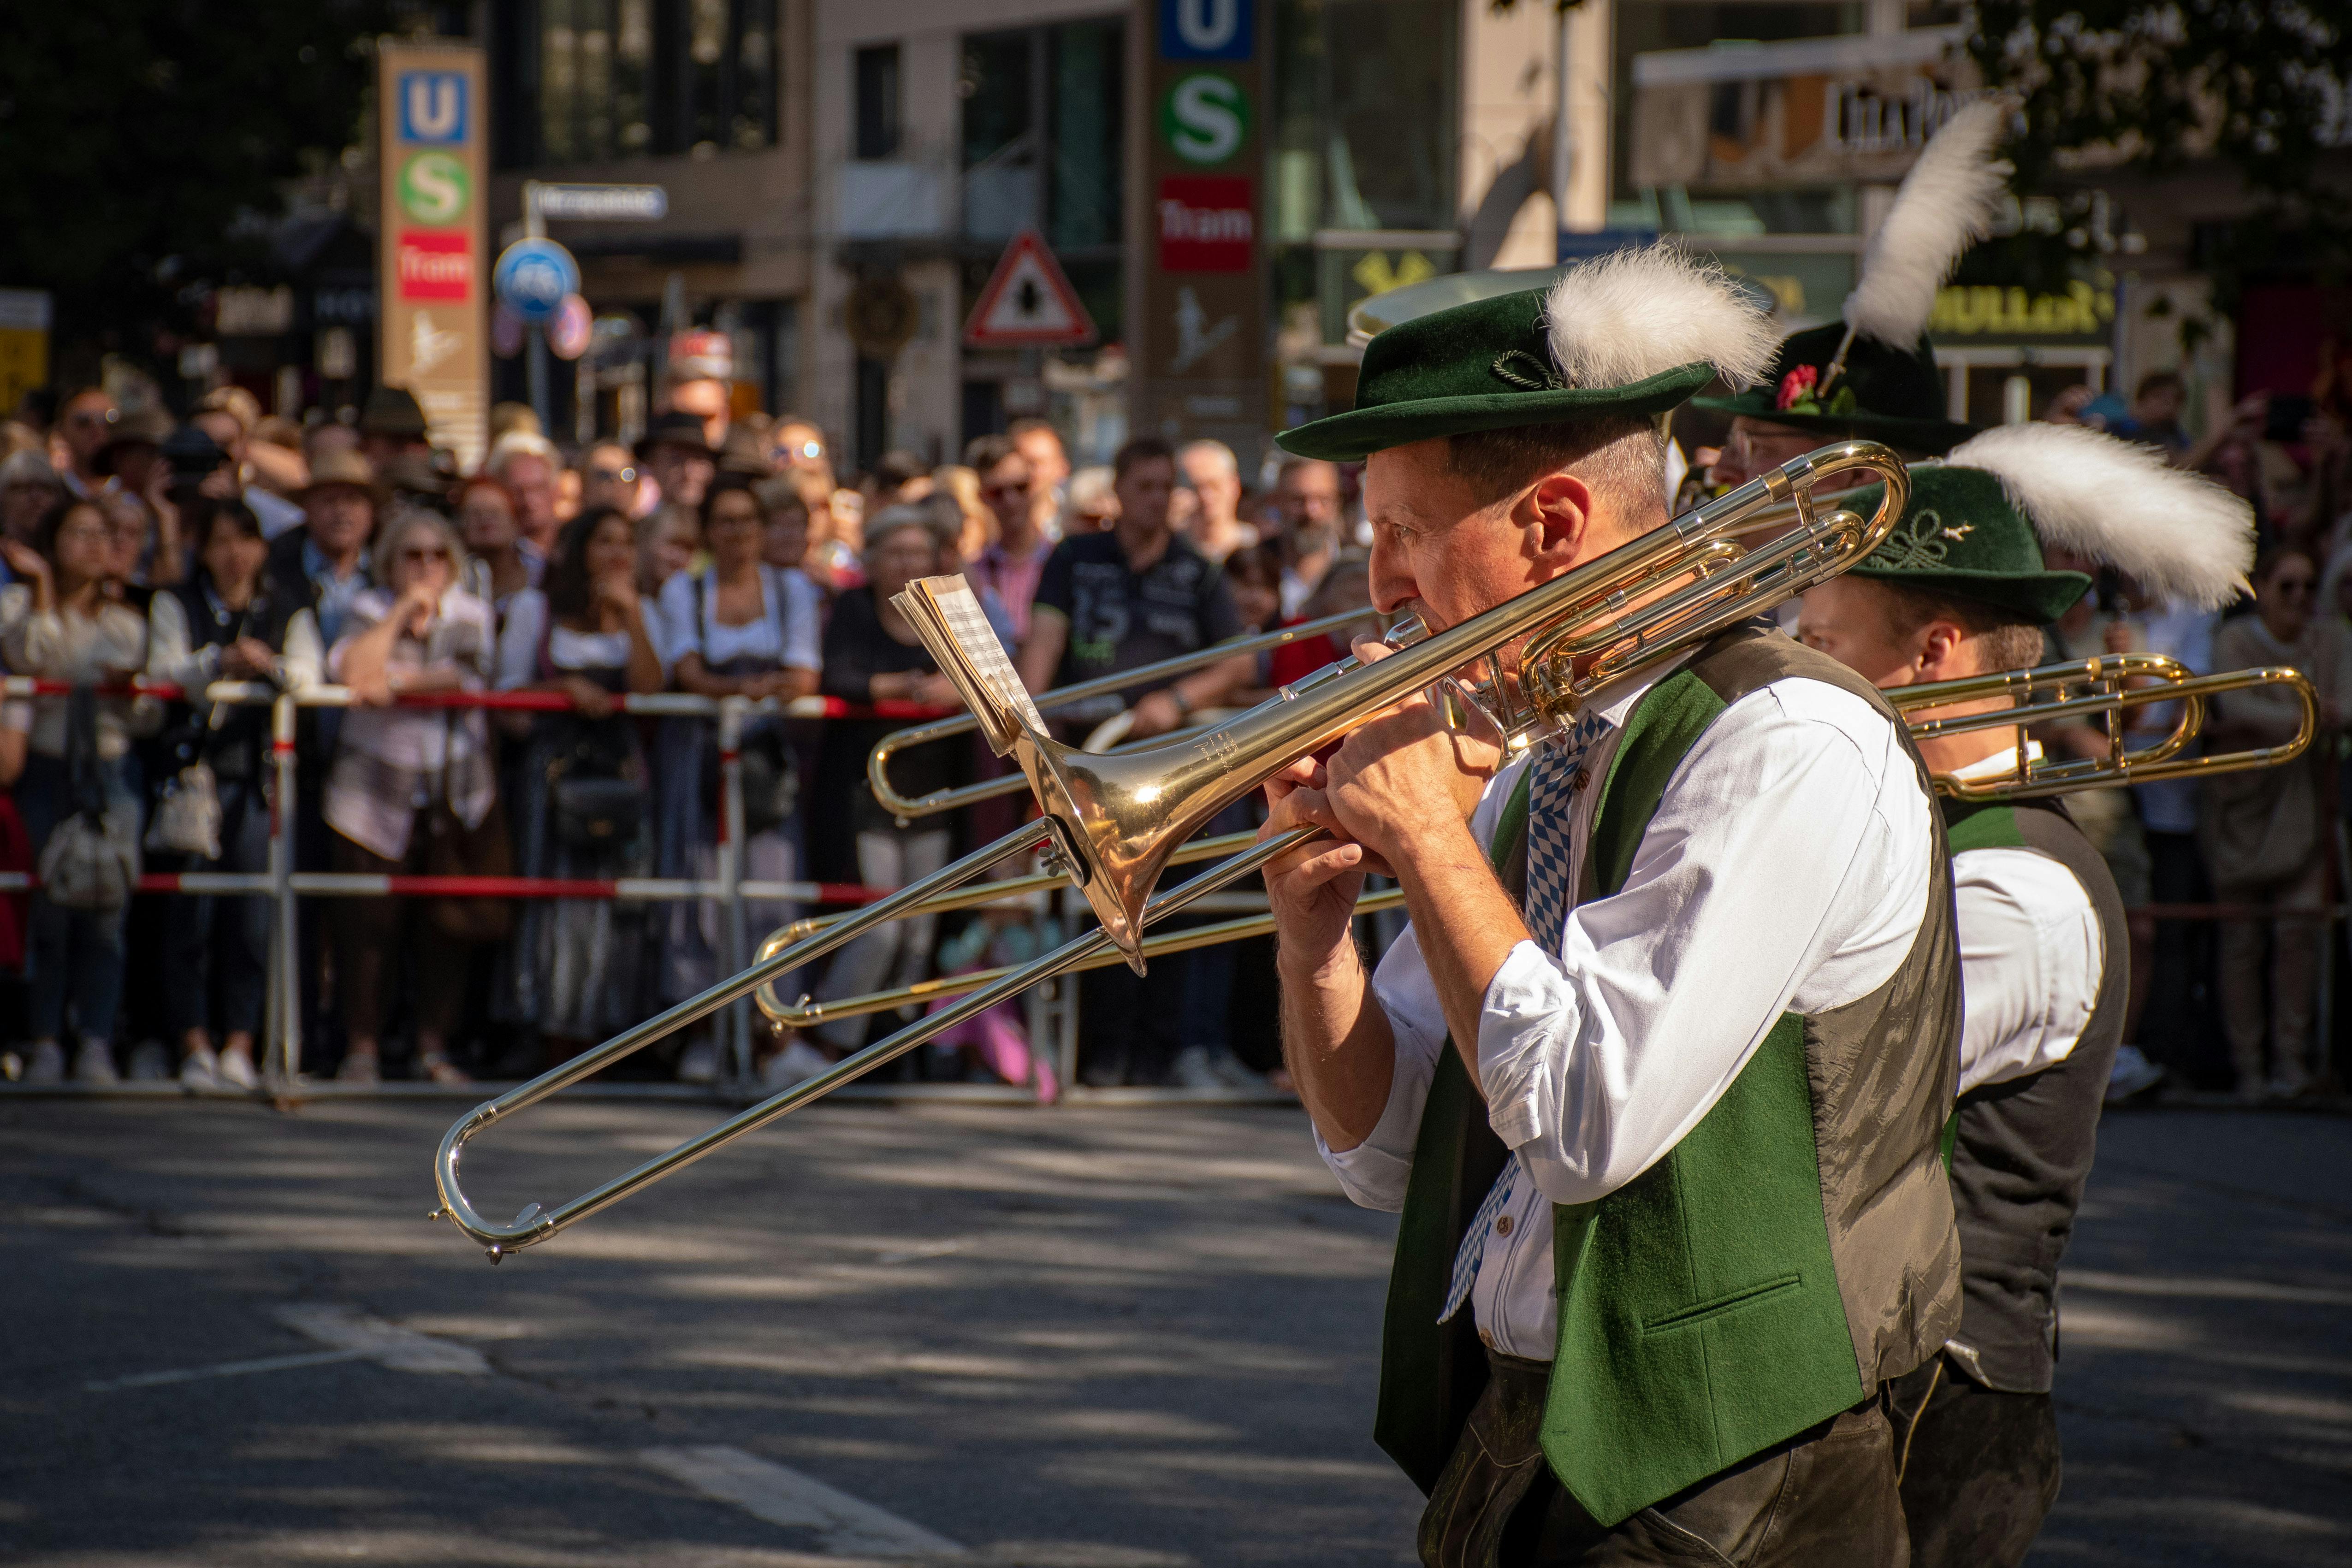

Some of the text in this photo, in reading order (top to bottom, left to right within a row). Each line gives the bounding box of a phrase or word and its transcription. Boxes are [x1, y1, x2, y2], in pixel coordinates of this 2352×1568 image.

[408, 79, 456, 137] U
[1172, 74, 1245, 163] S
[409, 152, 462, 216] S
[1161, 199, 1253, 240] Tram
[400, 246, 468, 278] Tram
